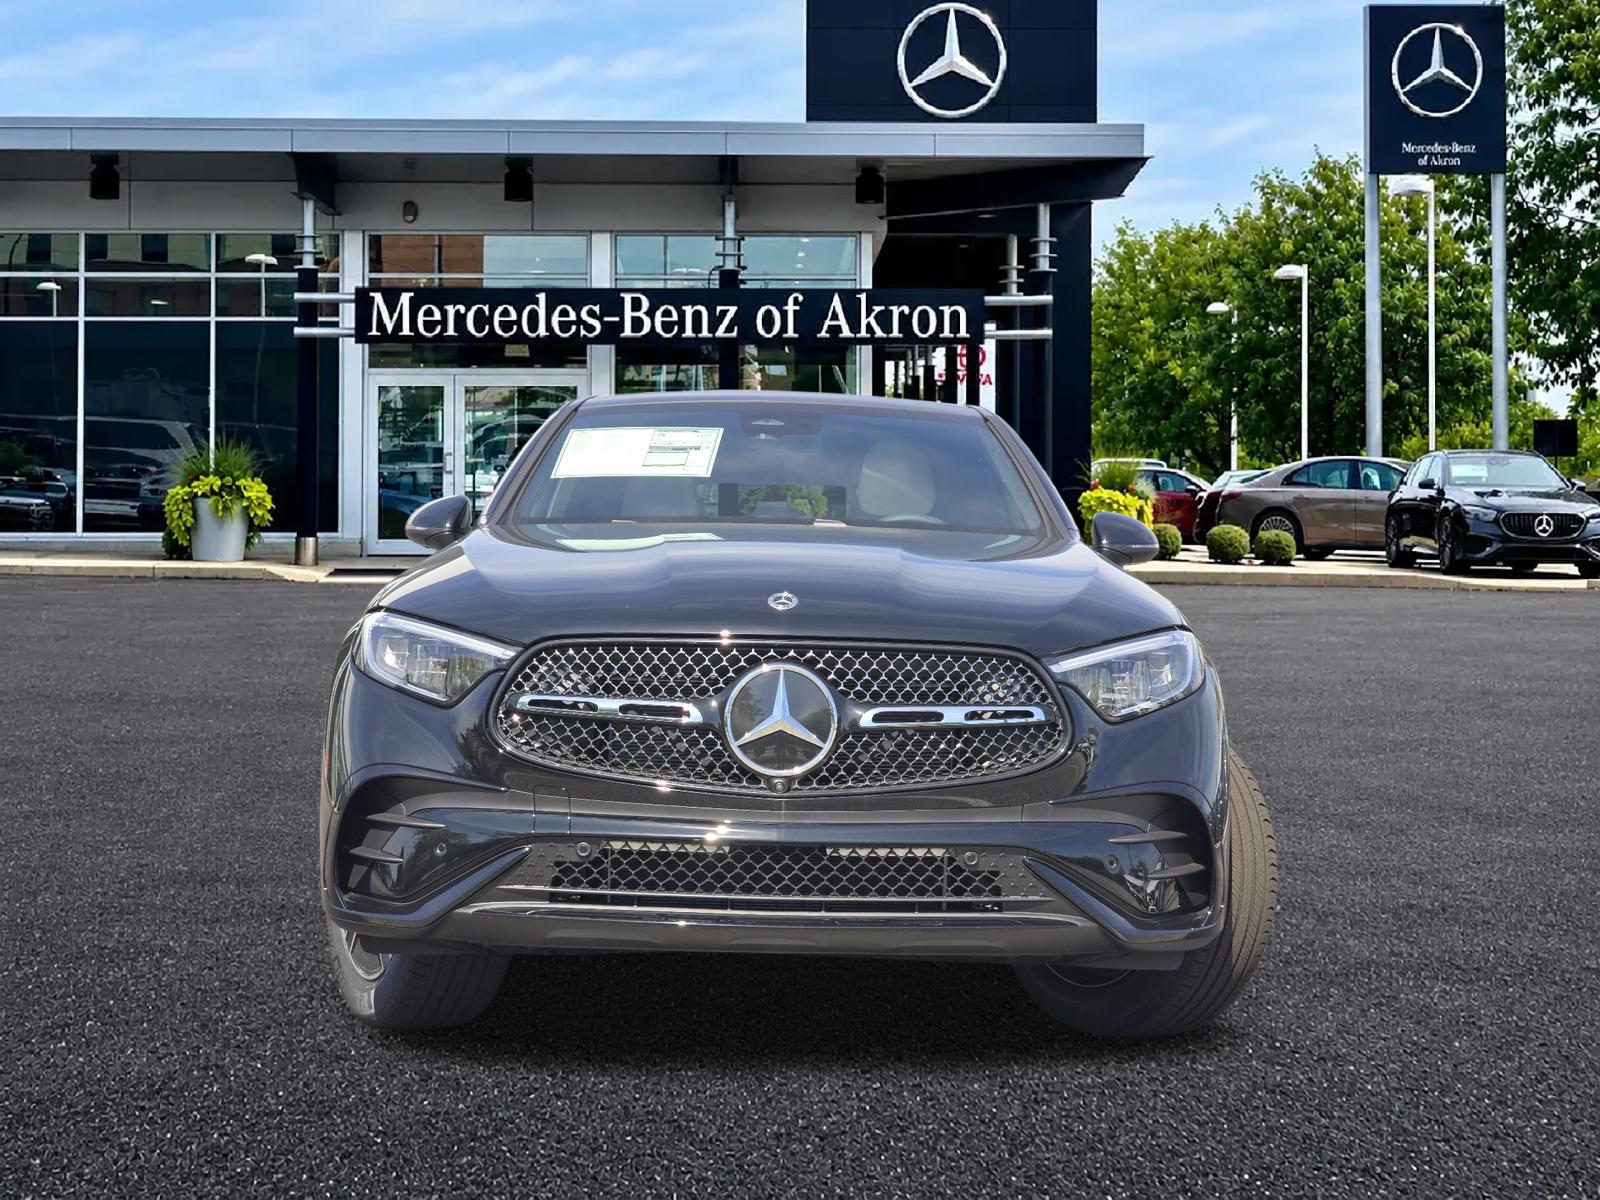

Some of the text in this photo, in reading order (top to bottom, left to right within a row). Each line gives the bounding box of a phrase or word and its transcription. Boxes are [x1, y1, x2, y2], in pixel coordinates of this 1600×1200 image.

[1401, 142, 1476, 153] Mercedes-Benz
[1417, 154, 1461, 166] of Akron
[368, 291, 971, 339] Mercedes-Benz of Akron
